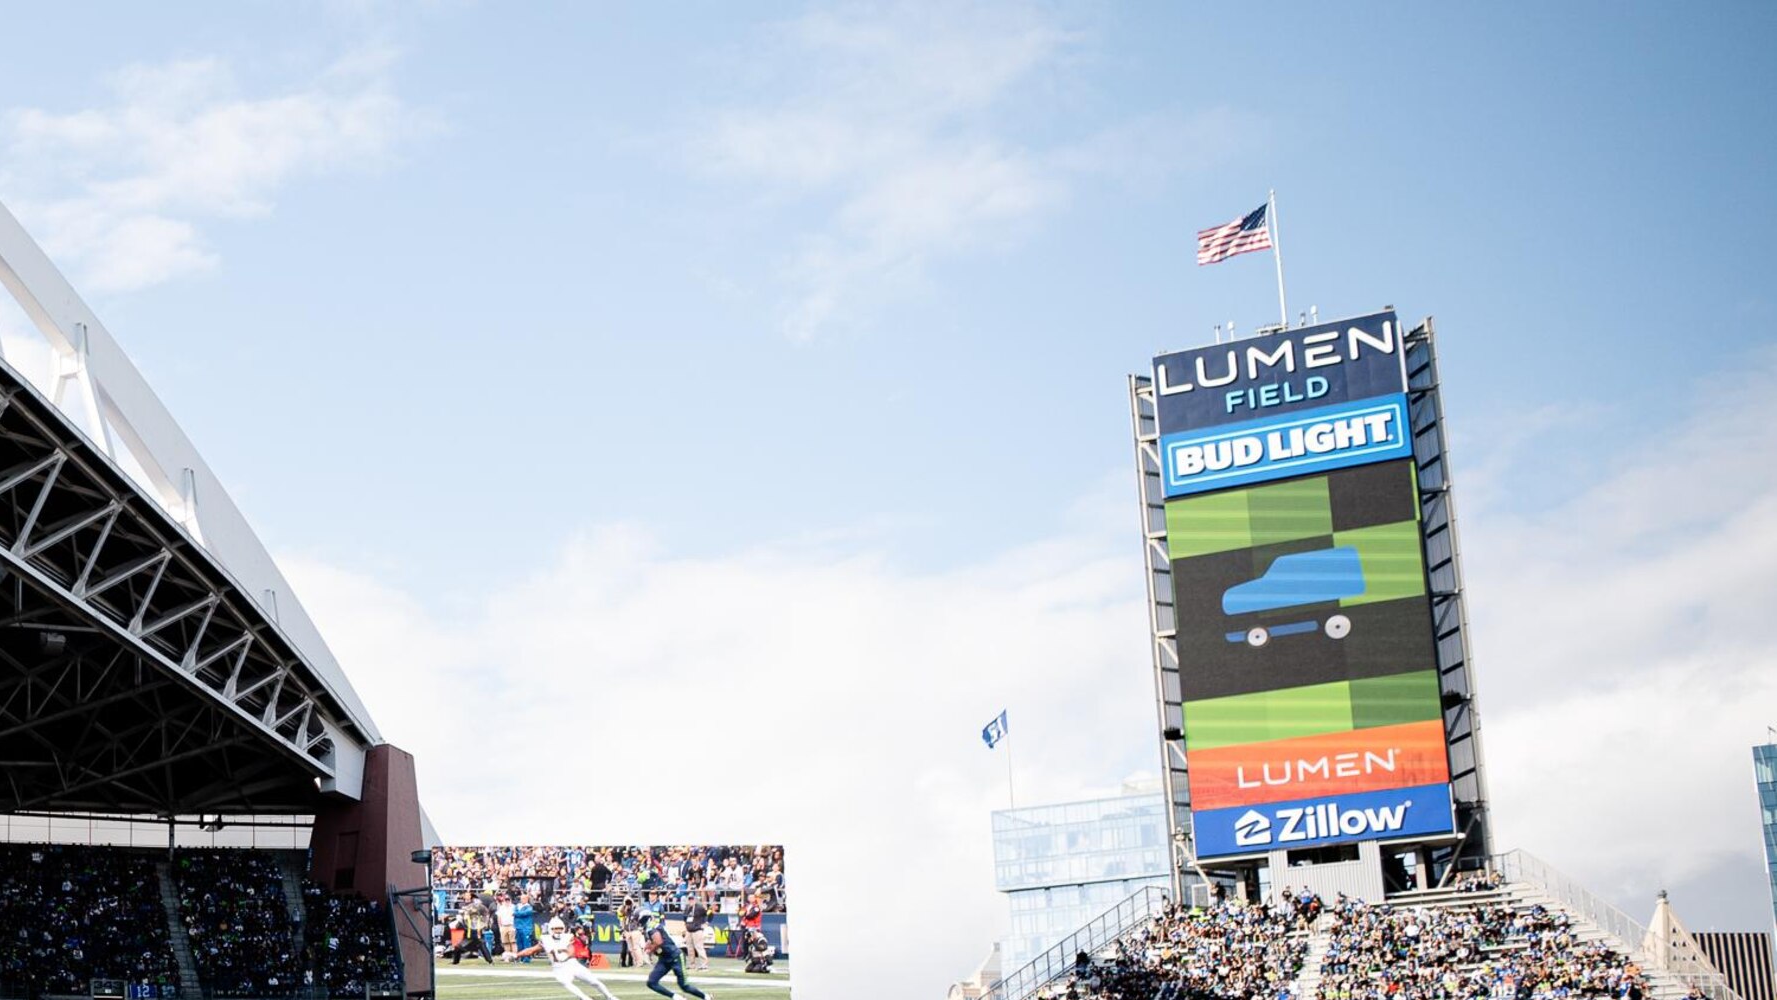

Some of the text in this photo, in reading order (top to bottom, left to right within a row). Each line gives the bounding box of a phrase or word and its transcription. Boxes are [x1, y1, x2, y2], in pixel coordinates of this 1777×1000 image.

[1157, 320, 1395, 397] LUMEN
[1225, 376, 1330, 414] FIELD
[1176, 412, 1392, 477] BUD LIGHT
[1237, 748, 1396, 789] LUMEN
[1276, 803, 1406, 842] Zillow
[136, 985, 150, 997] 12
